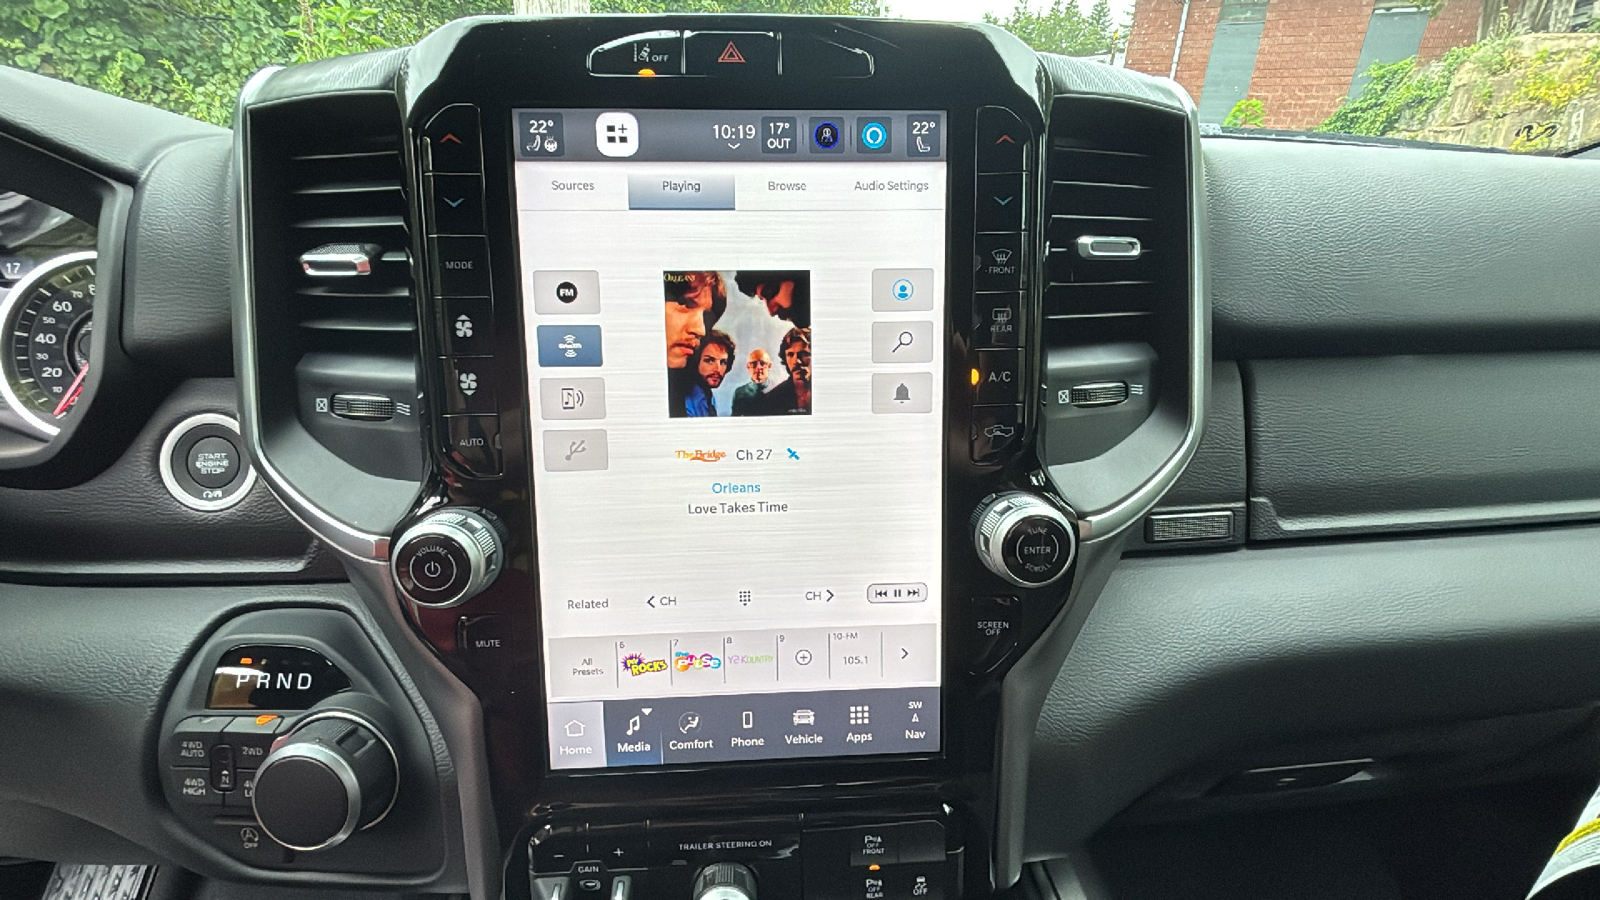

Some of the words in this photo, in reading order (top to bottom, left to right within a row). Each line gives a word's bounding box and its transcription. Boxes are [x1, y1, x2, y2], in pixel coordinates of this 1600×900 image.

[652, 54, 669, 62] OFF
[528, 120, 554, 135] 22°
[712, 124, 756, 140] 10:19
[769, 122, 790, 135] 17°
[912, 121, 936, 135] 22°
[767, 138, 791, 150] OUT
[551, 180, 595, 191] Sources
[662, 180, 701, 194] Playing
[767, 180, 807, 191] Browse
[854, 180, 885, 192] Audio
[887, 180, 929, 194] Settings
[6, 263, 20, 274] 17
[445, 260, 474, 270] MODE
[989, 266, 1015, 275] FRONT
[70, 290, 83, 299] 70
[559, 289, 574, 297] FM
[52, 302, 73, 313] 60
[990, 323, 1013, 333] REAR
[35, 333, 57, 345] 40
[41, 367, 63, 378] 20
[989, 370, 1011, 382] A/C
[52, 386, 63, 394] 10
[459, 438, 484, 447] AUTO
[675, 450, 693, 459] The
[692, 449, 727, 462] Bridge
[736, 449, 753, 460] Ch
[756, 449, 772, 460] 27
[195, 460, 229, 468] ENGINE
[711, 482, 761, 494] Orleans
[688, 503, 717, 514] Love
[719, 502, 755, 513] Takes
[757, 501, 788, 512] Time
[1027, 526, 1049, 536] TUNE
[415, 544, 448, 558] VOLUME
[1024, 546, 1052, 555] ENTER
[1024, 562, 1052, 573] SCROLL
[659, 596, 677, 606] CH
[805, 591, 822, 601] CH
[567, 598, 609, 610] Related
[977, 621, 1009, 629] SCREEN
[832, 632, 859, 640] 10-FM
[475, 639, 500, 648] MUTE
[581, 658, 592, 667] All
[842, 655, 869, 665] 105.1
[572, 667, 604, 676] Presets
[631, 660, 667, 676] ROCKS
[907, 701, 923, 709] SW
[785, 733, 823, 744] Vehicle
[846, 732, 873, 744] Apps
[905, 730, 926, 739] Nav
[181, 741, 203, 749] 4WD
[669, 739, 714, 750] Comfort
[731, 737, 765, 747] Phone
[242, 746, 263, 756] 2WD
[559, 746, 592, 756] Home
[617, 742, 651, 753] Media
[180, 749, 205, 758] AUTO
[184, 778, 205, 787] 4WD
[182, 787, 206, 796] HIGH
[679, 842, 714, 851] TRAILER
[715, 840, 757, 850] STEERING
[758, 839, 772, 848] ON
[862, 848, 885, 856] FRONT
[577, 865, 599, 874] GAIN
[912, 888, 928, 896] OFF
